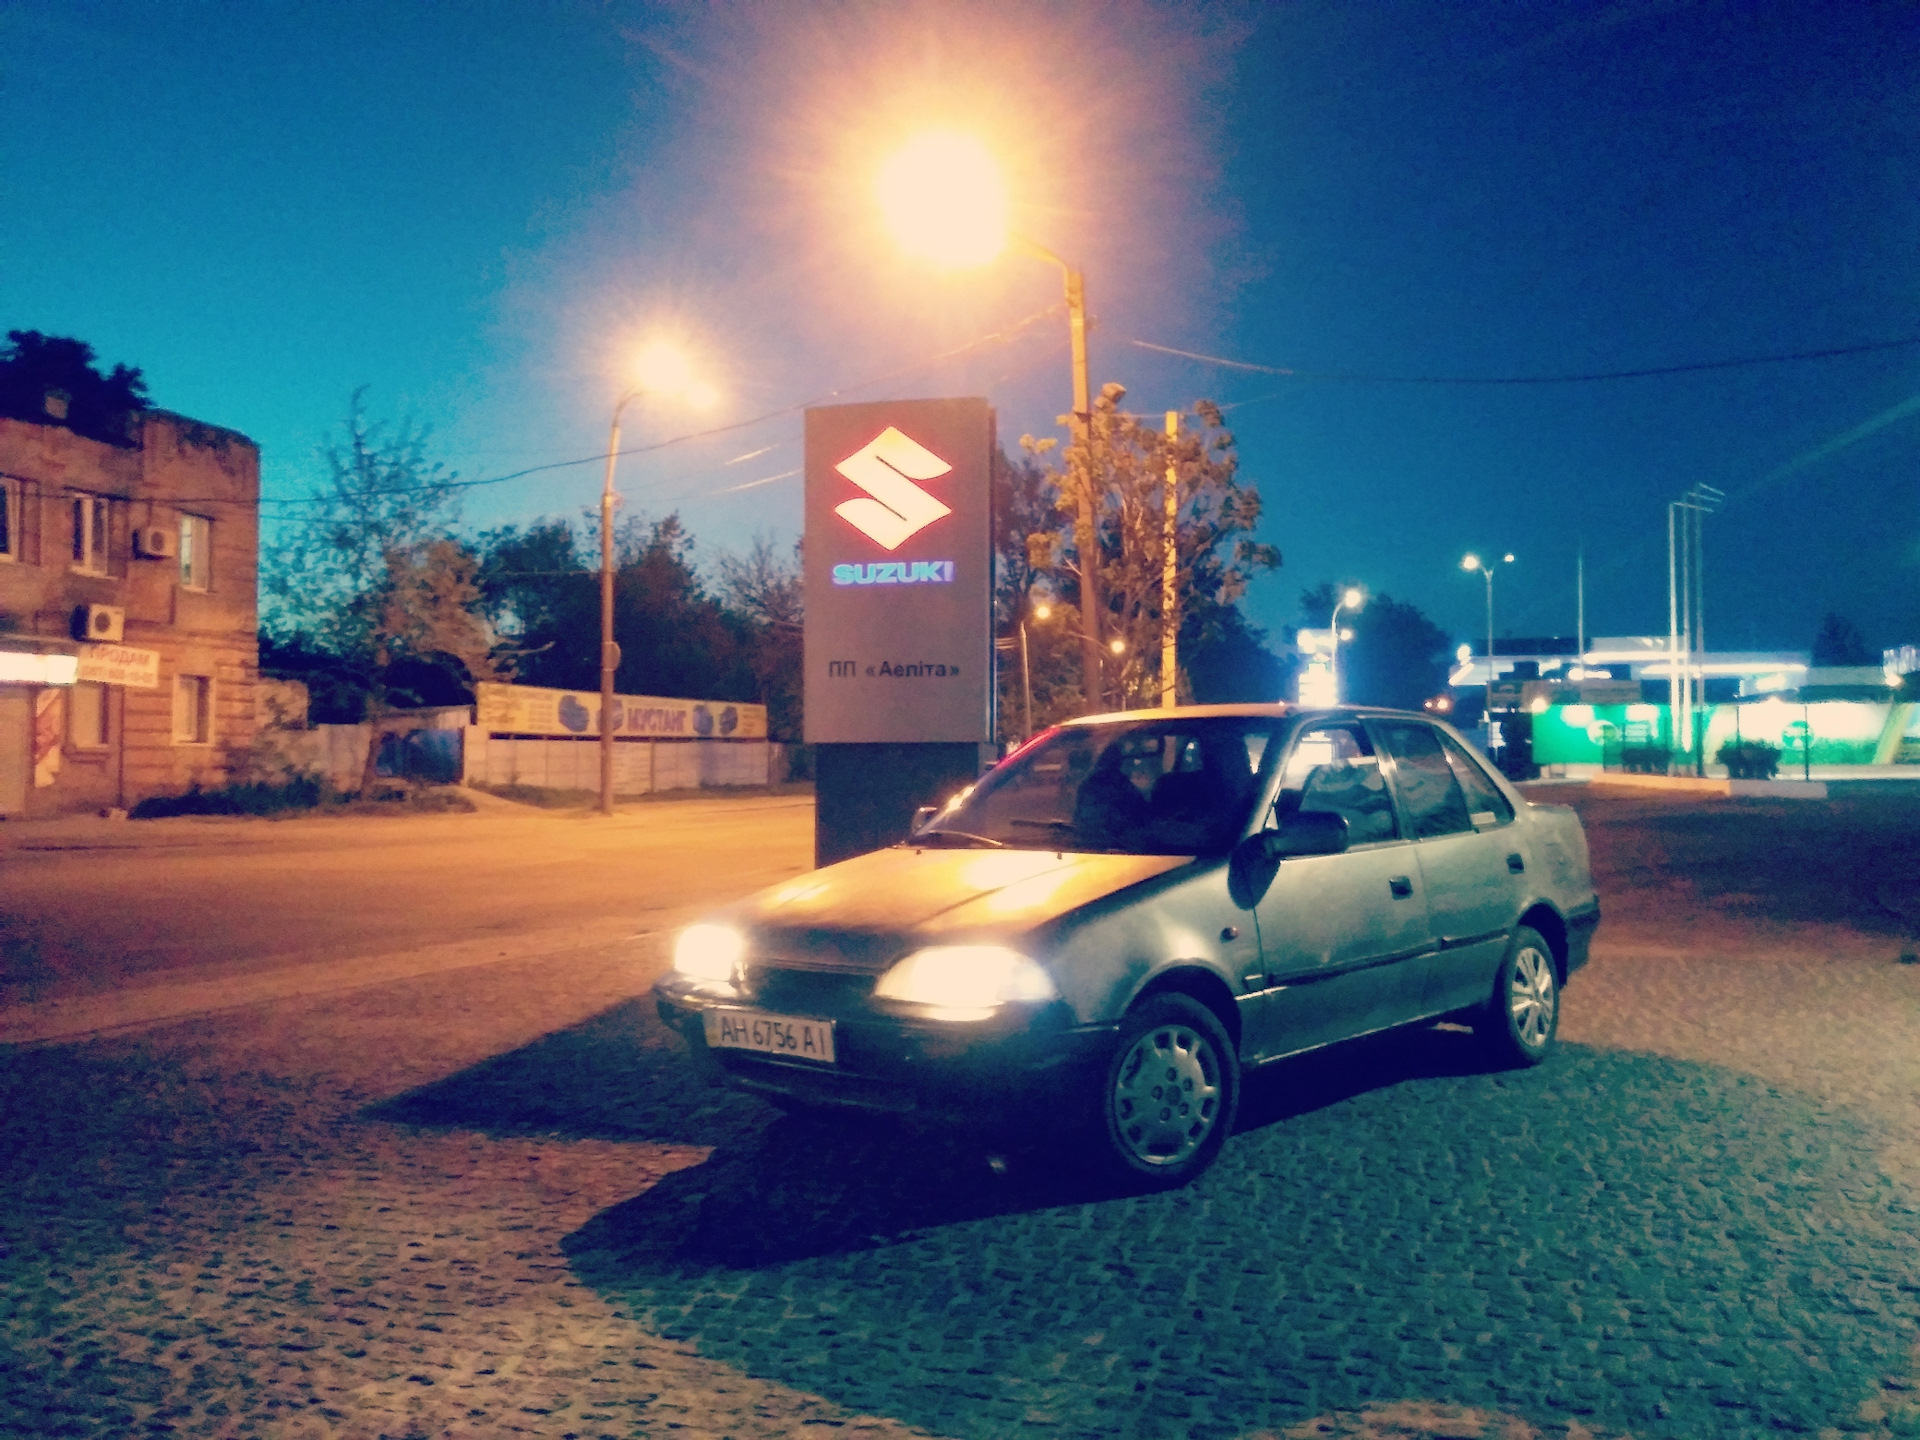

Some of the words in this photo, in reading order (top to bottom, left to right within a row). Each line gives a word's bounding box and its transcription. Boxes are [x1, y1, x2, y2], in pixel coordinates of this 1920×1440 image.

[832, 560, 954, 585] SUZUKI
[828, 660, 856, 678] ПП
[721, 1016, 749, 1043] AH
[752, 1019, 798, 1050] 6756
